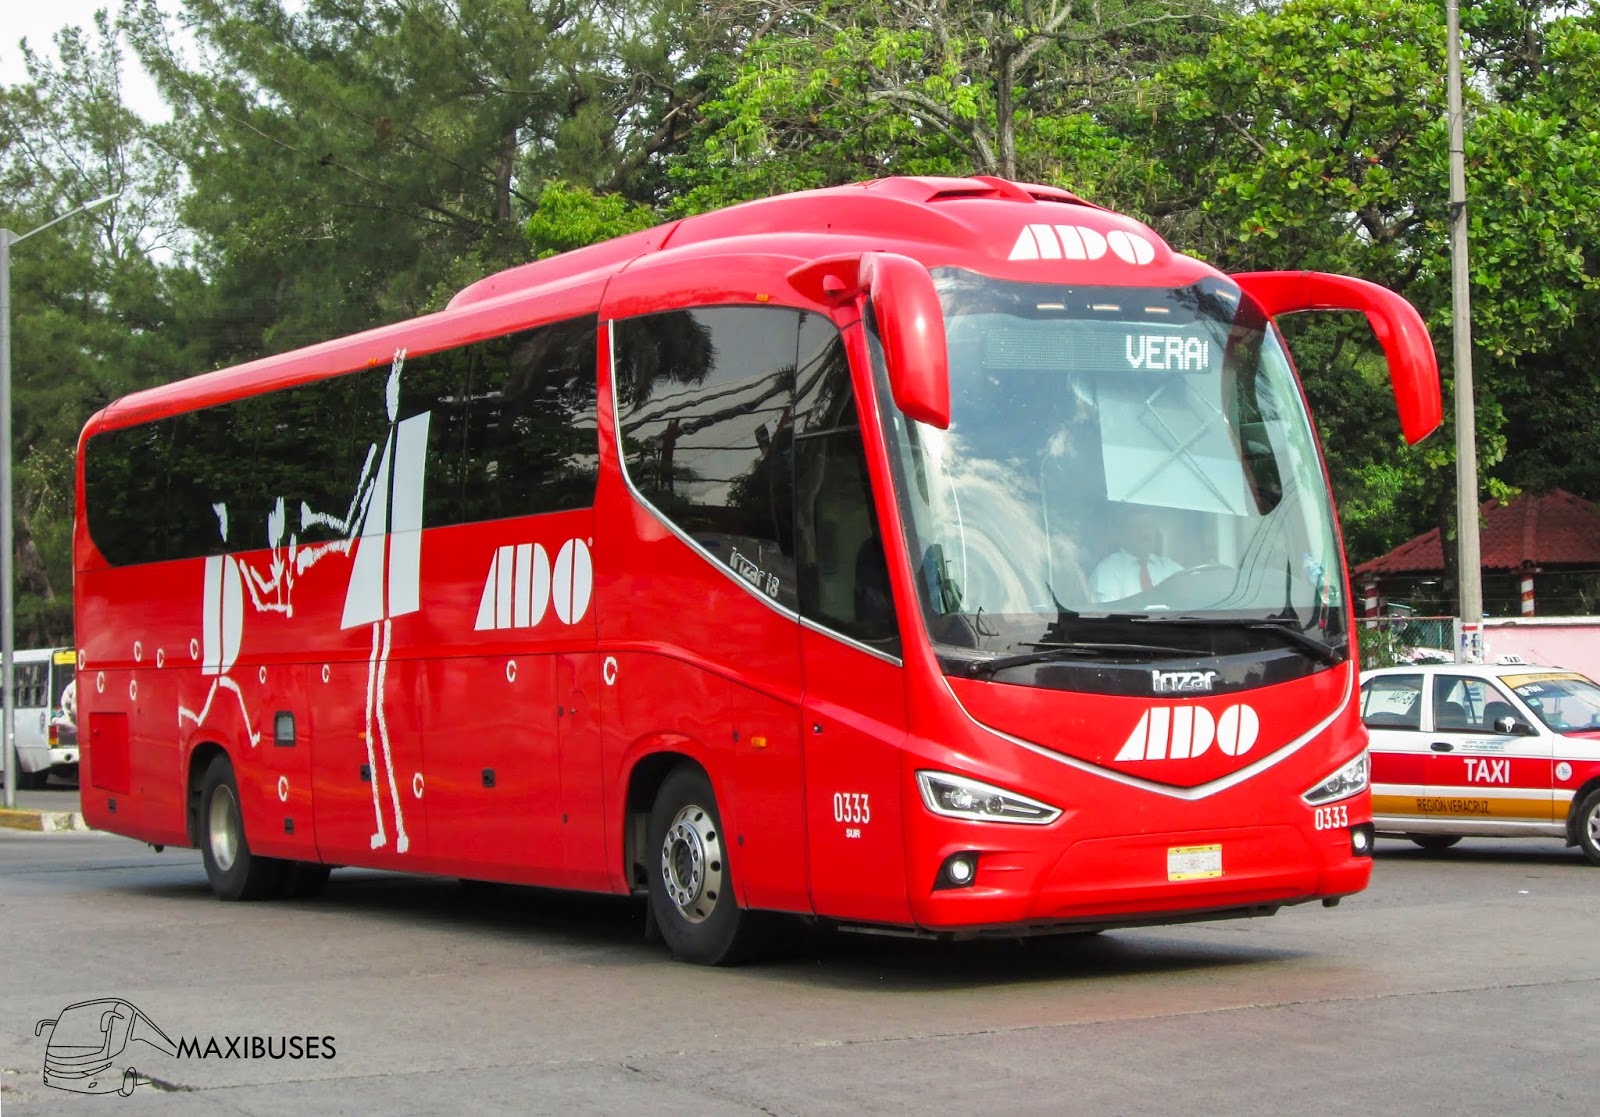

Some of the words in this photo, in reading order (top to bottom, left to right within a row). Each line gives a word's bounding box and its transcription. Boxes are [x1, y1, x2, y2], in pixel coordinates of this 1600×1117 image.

[1008, 223, 1156, 265] ADO
[474, 537, 594, 631] ADO
[765, 572, 780, 598] i8
[1113, 703, 1260, 762] ADO
[1463, 758, 1511, 784] TAXI
[833, 792, 871, 825] 0333
[1314, 806, 1349, 831] 0333
[1447, 799, 1490, 814] VERACRUZ
[845, 828, 861, 839] SUR
